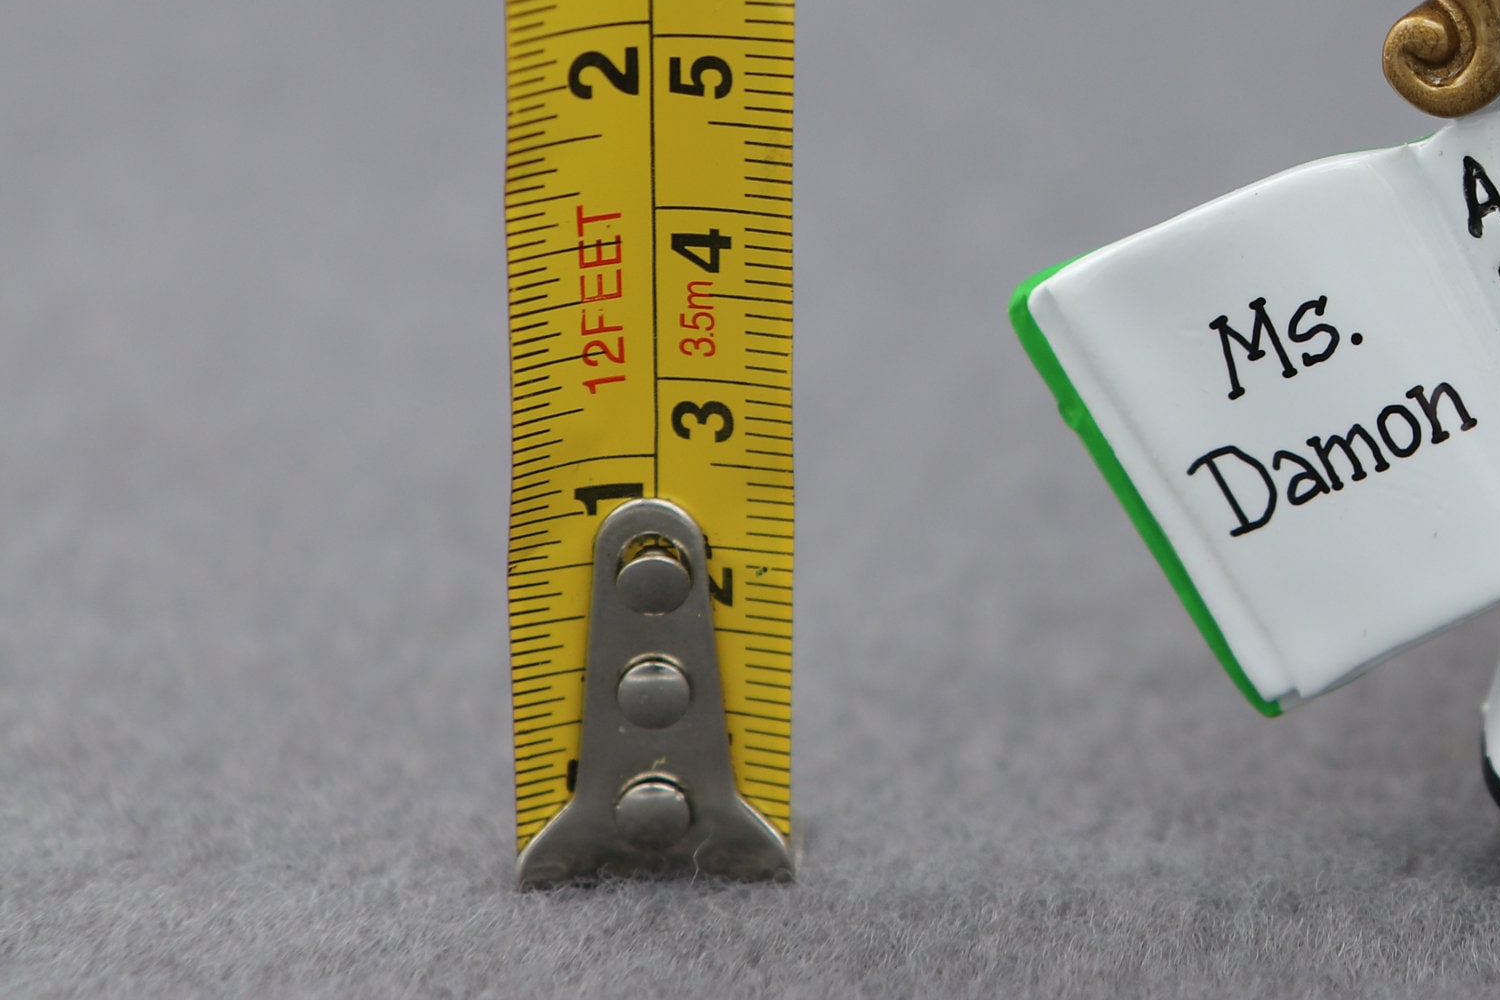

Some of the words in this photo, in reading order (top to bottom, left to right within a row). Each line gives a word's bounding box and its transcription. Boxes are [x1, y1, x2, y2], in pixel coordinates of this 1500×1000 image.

[567, 45, 639, 100] 2
[669, 55, 733, 100] 5
[671, 228, 732, 274] 4
[576, 204, 627, 395] 12FEET
[679, 280, 717, 358] 3.5m
[1208, 294, 1365, 401] Ms.
[671, 400, 734, 443] 3
[1186, 380, 1479, 539] Damon
[573, 482, 644, 516] 1
